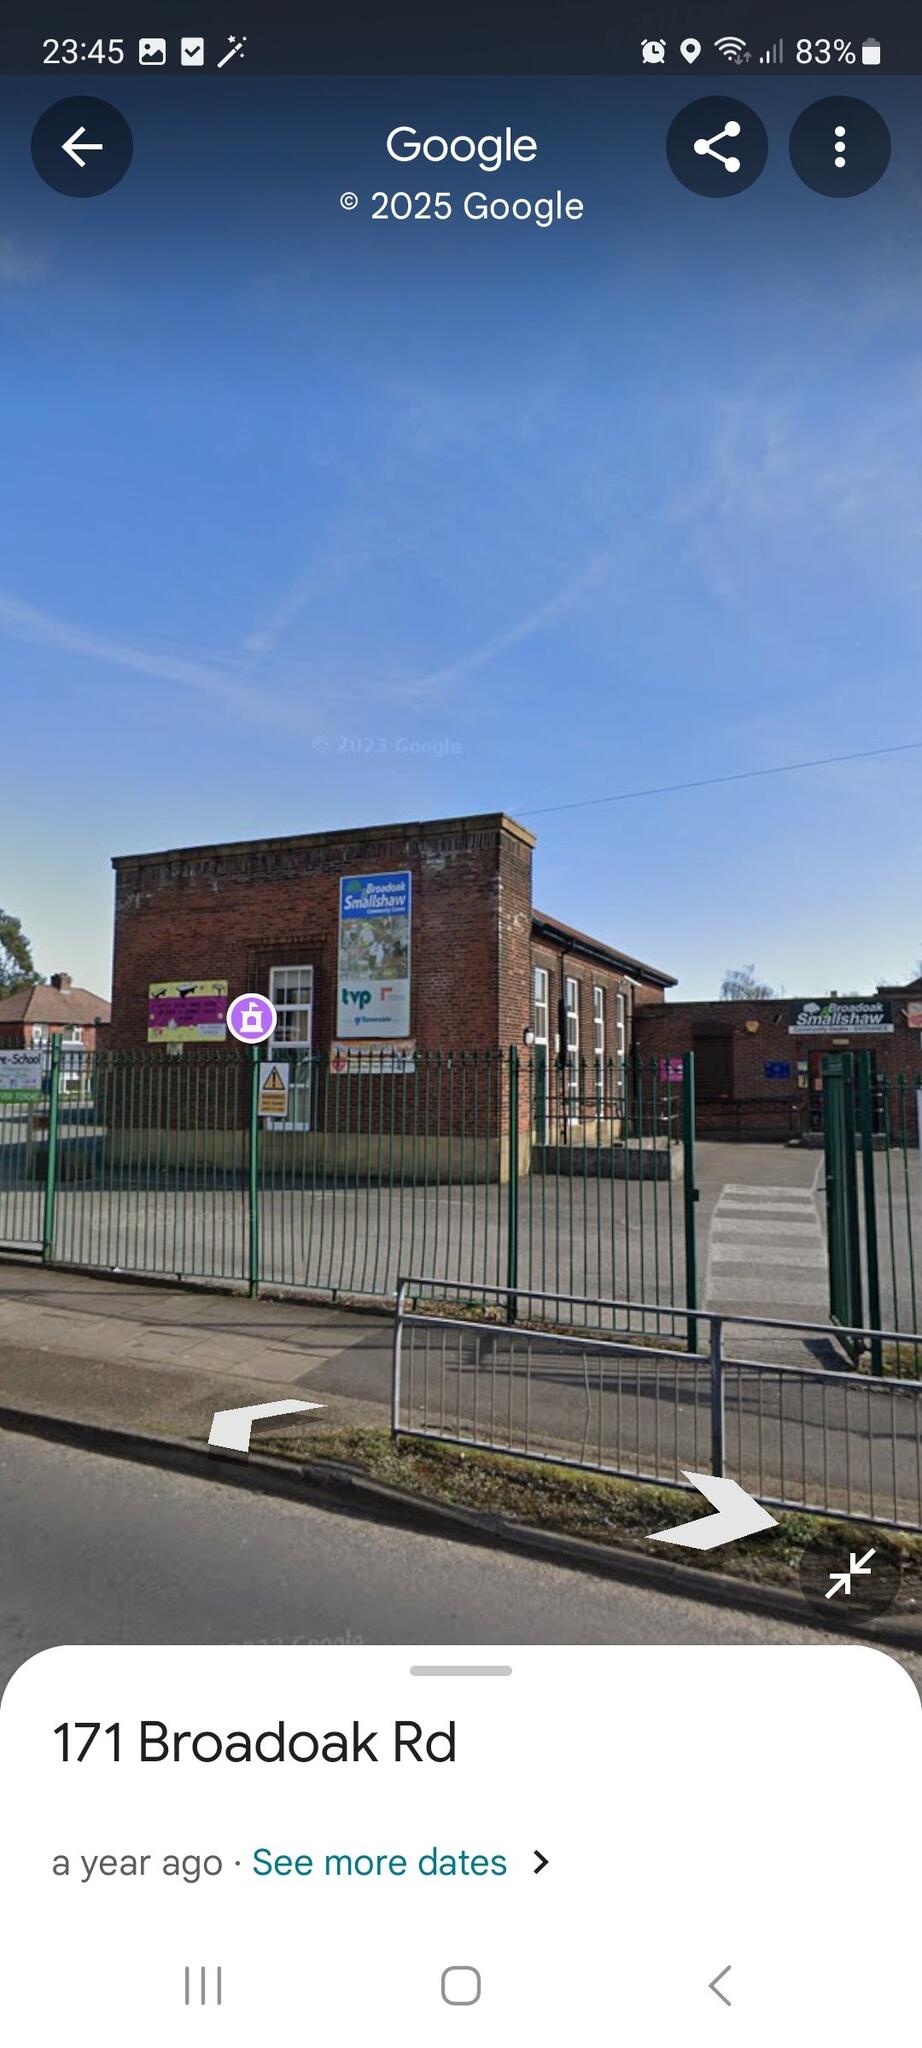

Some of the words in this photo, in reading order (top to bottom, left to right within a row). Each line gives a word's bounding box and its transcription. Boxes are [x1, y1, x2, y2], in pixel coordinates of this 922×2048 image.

[366, 881, 407, 894] Broadoak
[344, 894, 407, 911] Smallshaw
[342, 988, 372, 1010] tvp
[829, 1002, 884, 1013] Broadoak
[796, 1012, 884, 1025] Smallshaw
